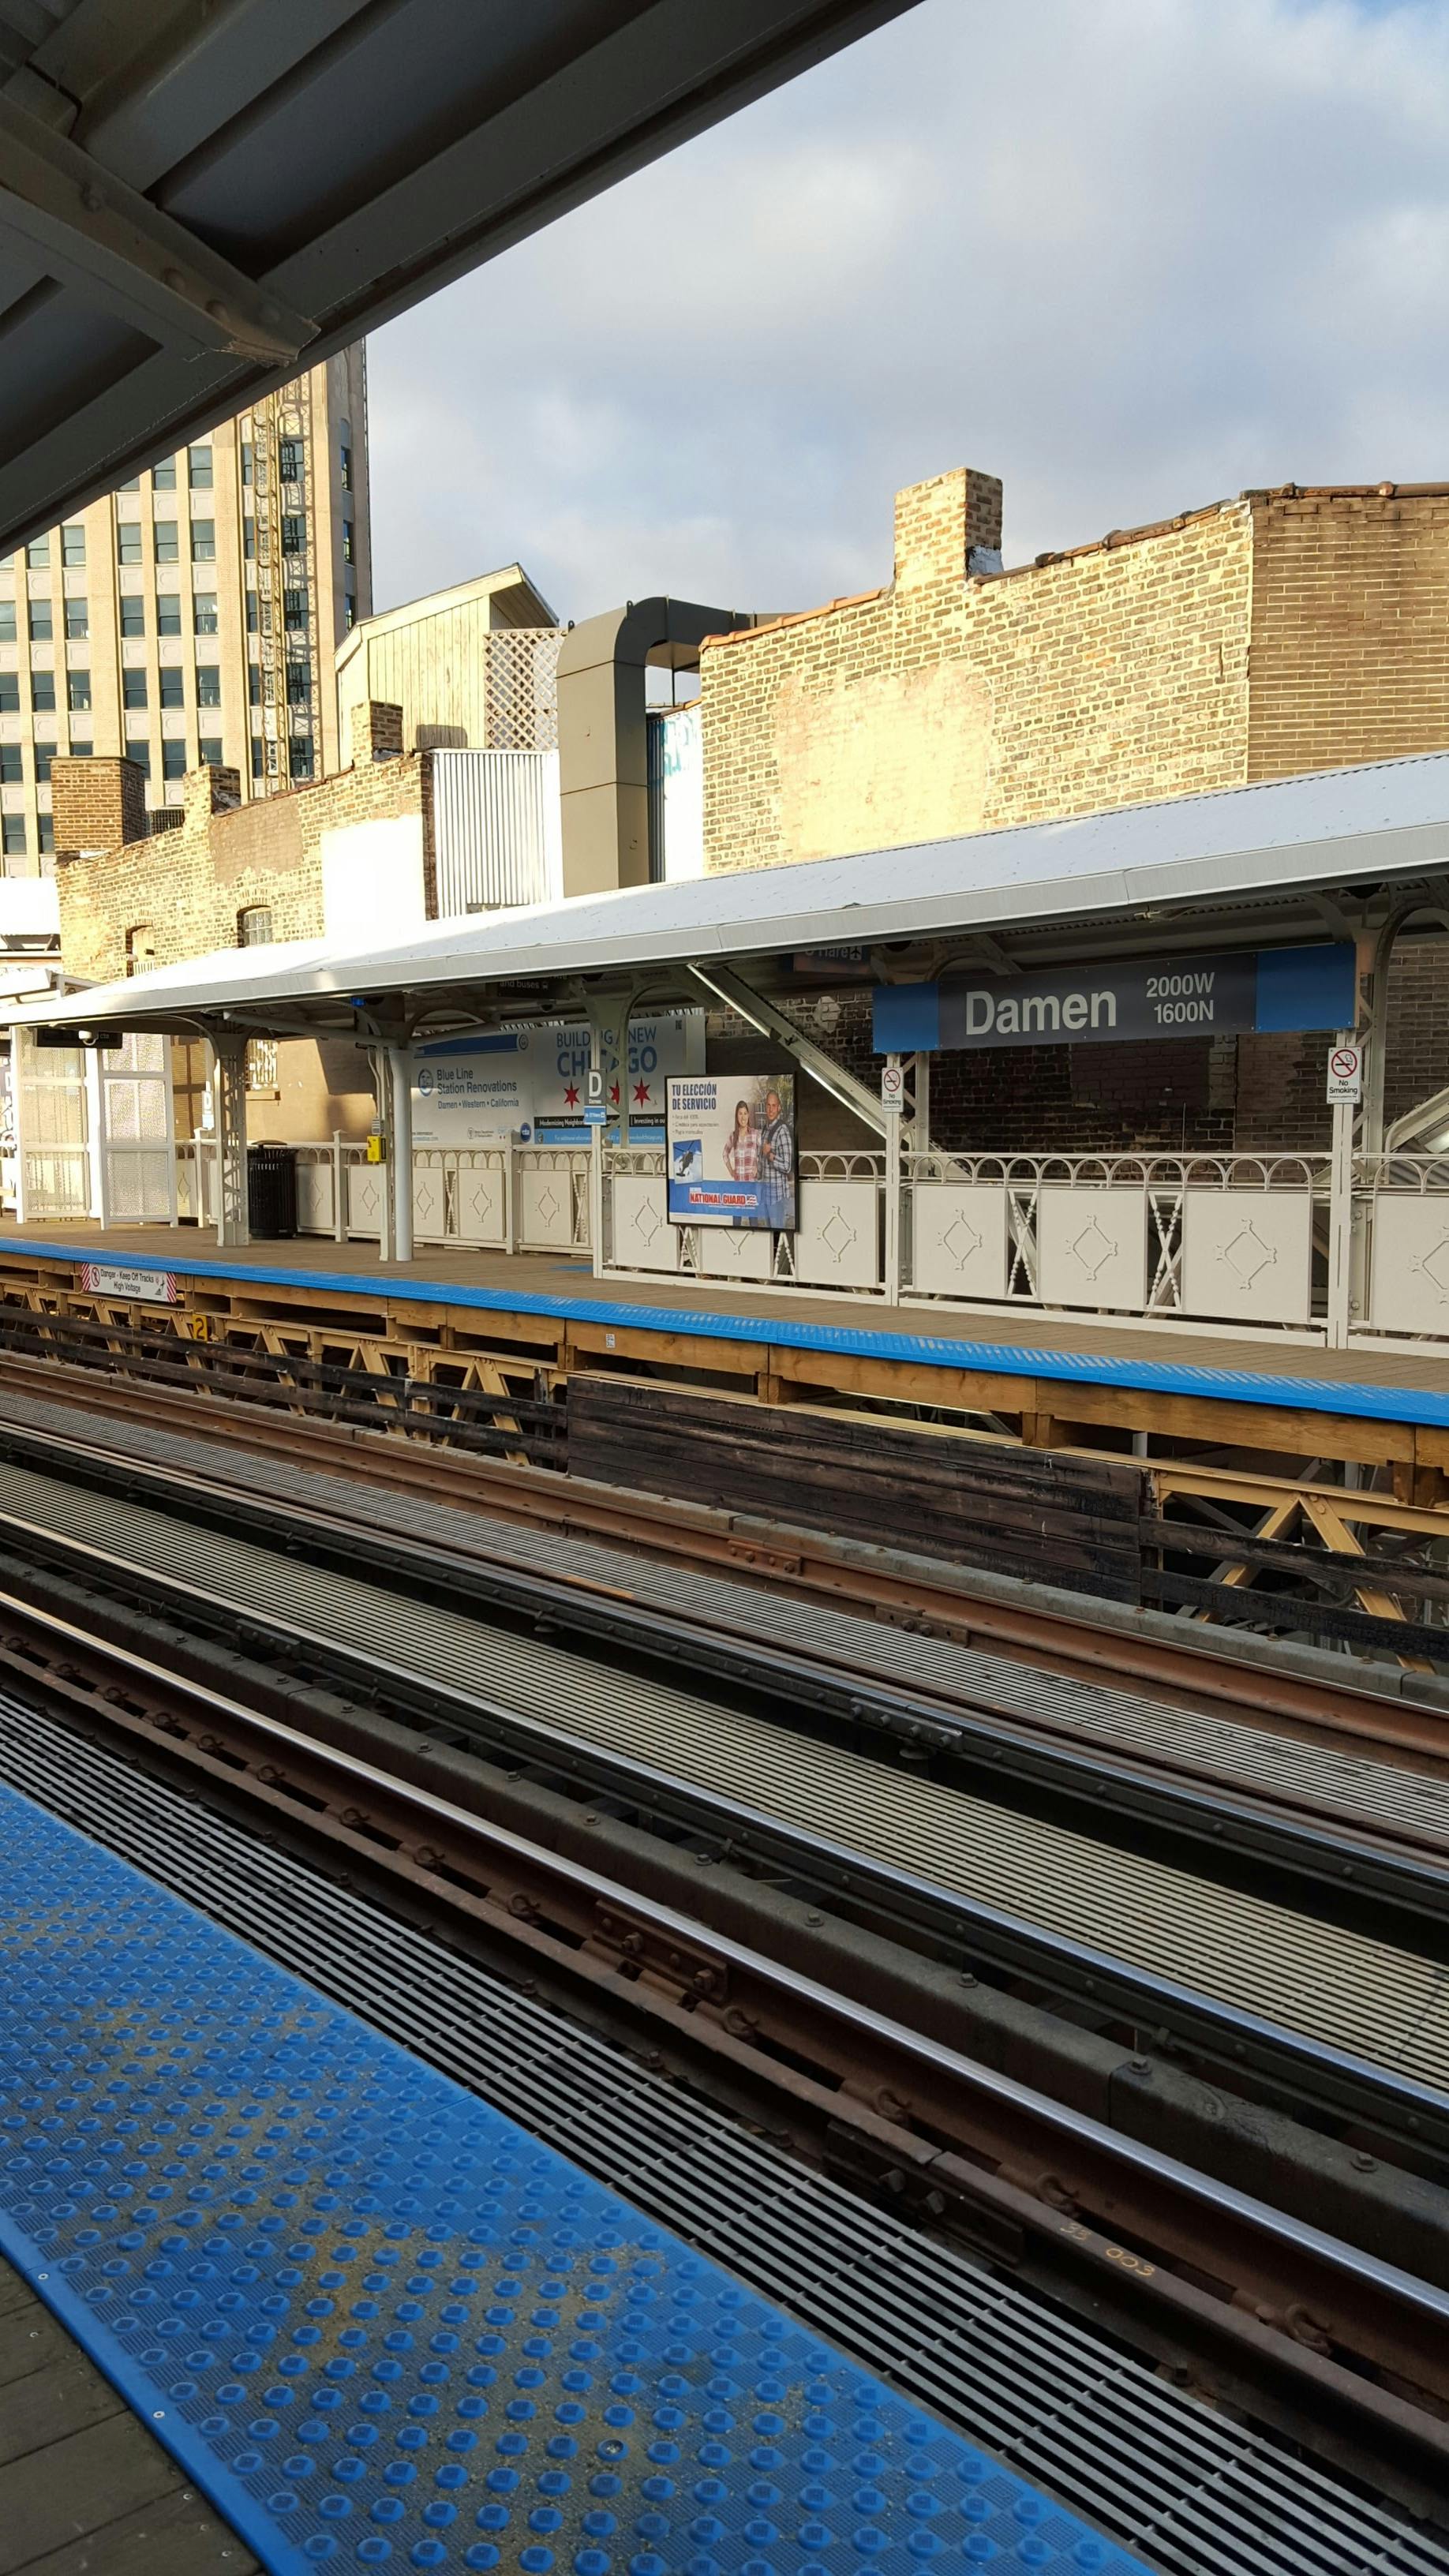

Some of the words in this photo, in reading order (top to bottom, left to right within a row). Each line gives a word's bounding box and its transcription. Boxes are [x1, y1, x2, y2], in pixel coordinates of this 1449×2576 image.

[966, 990, 1117, 1035] Damen
[1146, 972, 1215, 998] 2000W
[1154, 999, 1215, 1024] 1600N
[556, 1029, 613, 1048] BUILDG
[627, 1026, 657, 1043] NEW
[556, 1046, 657, 1077] CHIGO
[436, 1069, 455, 1080] Blue
[456, 1068, 474, 1080] Line
[437, 1082, 465, 1095] Station
[466, 1080, 518, 1094] Renovations
[589, 1071, 602, 1097] D
[672, 1084, 681, 1096] TU
[683, 1081, 717, 1096] ELECCIÓN
[1329, 1087, 1358, 1095] Smoking
[438, 1100, 458, 1110] Damen
[462, 1099, 486, 1109] Western
[490, 1098, 519, 1107] California
[672, 1099, 681, 1110] DE
[682, 1098, 717, 1110] SERVICIO
[690, 1193, 721, 1204] NATIONAL
[722, 1195, 746, 1205] GUARD
[100, 1268, 116, 1280] Danger
[119, 1271, 131, 1282] Keep
[131, 1272, 140, 1282] Off
[140, 1273, 154, 1283] Tracks
[114, 1281, 125, 1292] High
[125, 1282, 141, 1294] Voltage
[195, 1317, 205, 1340] 2
[1105, 2248, 1156, 2276] 003
